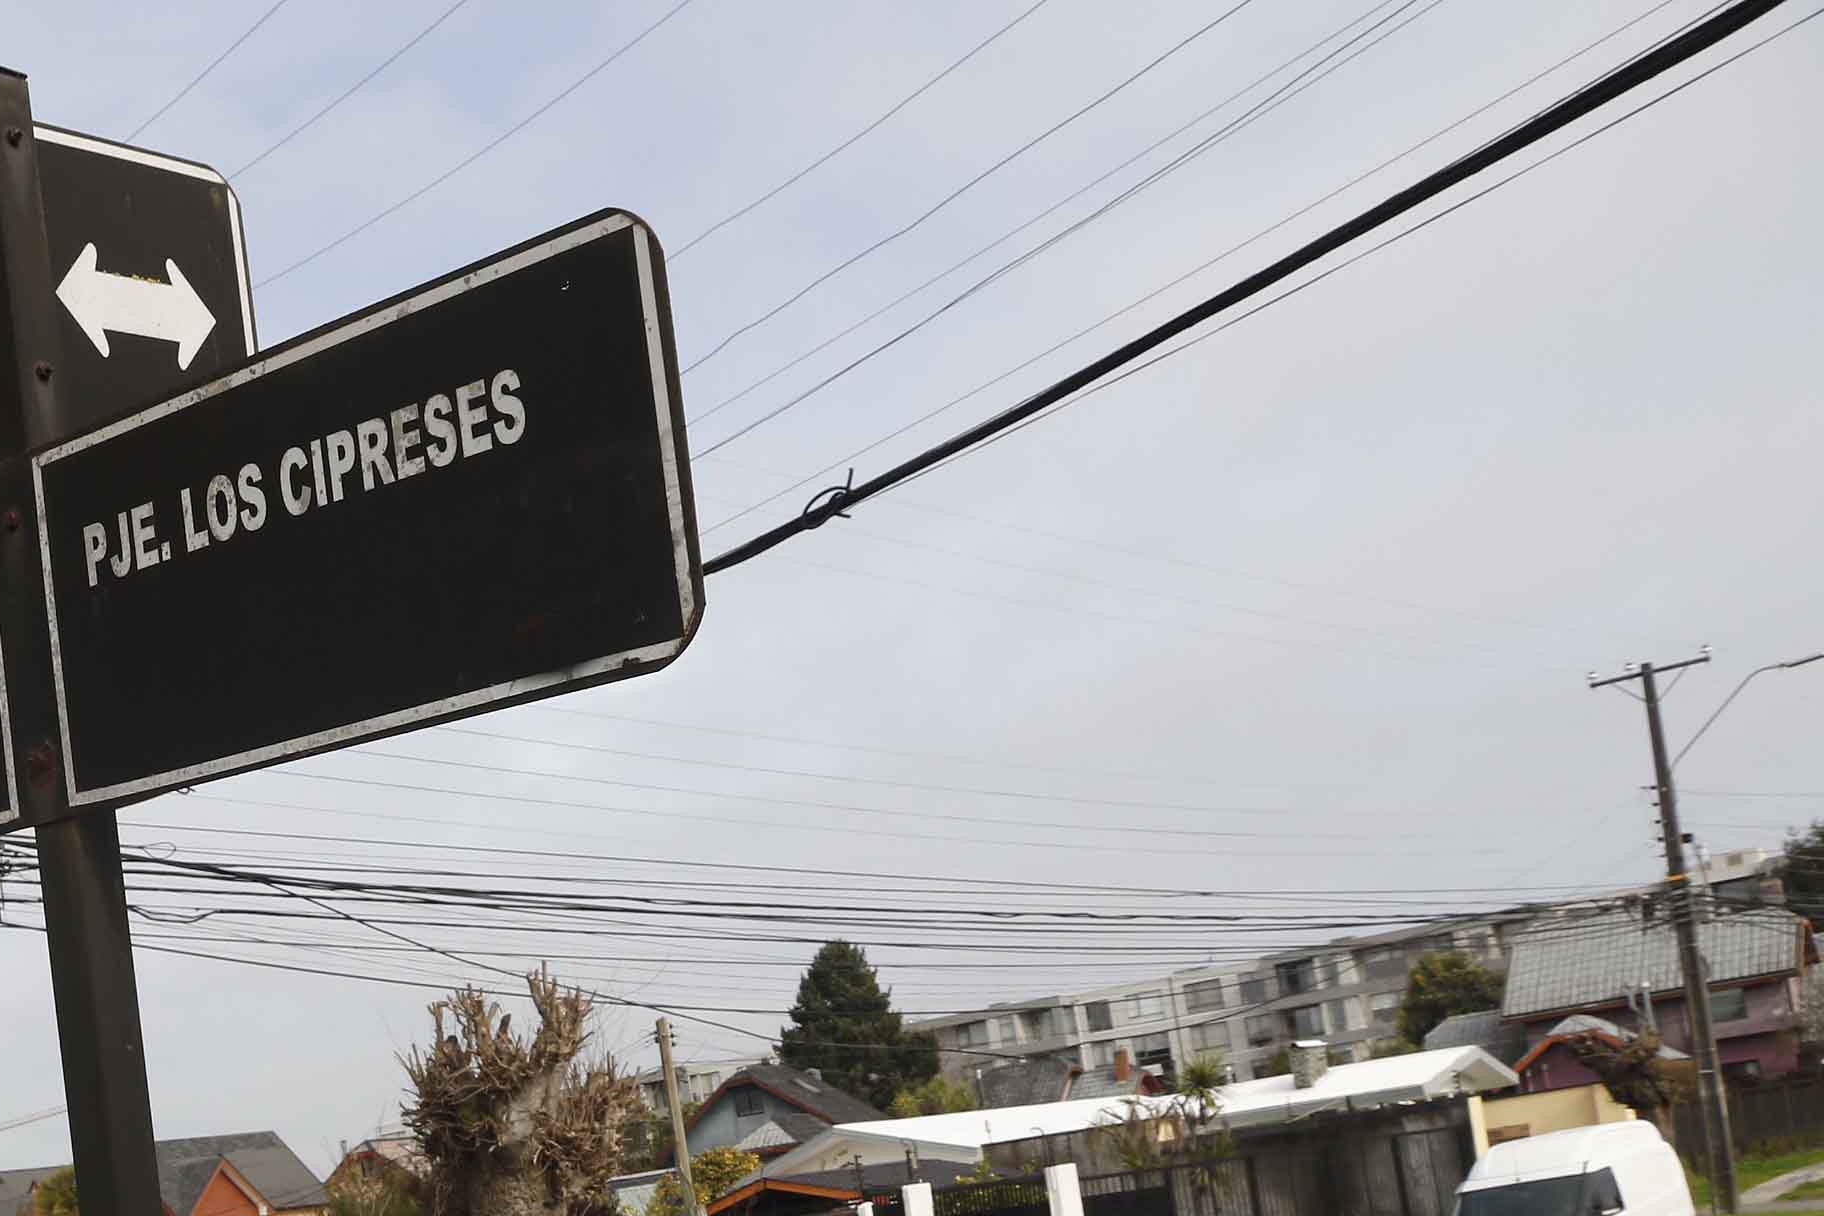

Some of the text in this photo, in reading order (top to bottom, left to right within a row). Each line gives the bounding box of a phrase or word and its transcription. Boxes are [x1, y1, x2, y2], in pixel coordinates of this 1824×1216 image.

[82, 369, 526, 587] PJE. LOS CIPRESES
